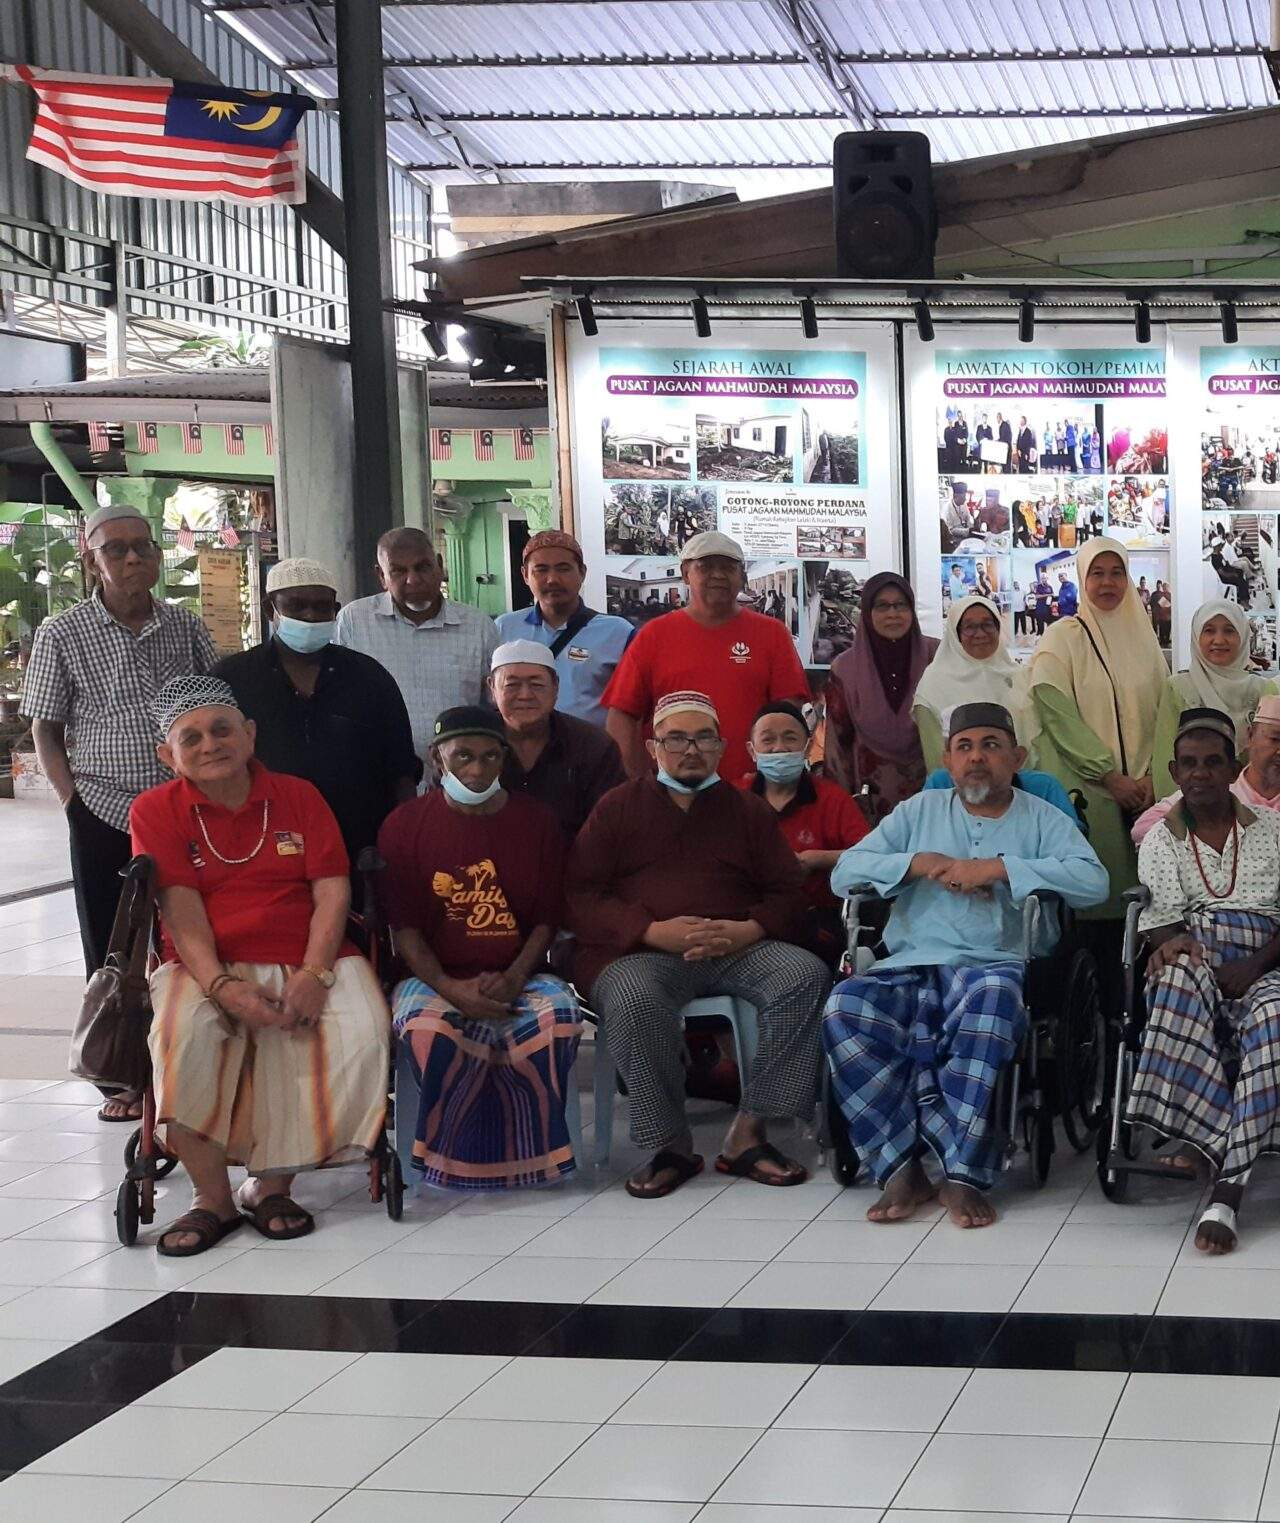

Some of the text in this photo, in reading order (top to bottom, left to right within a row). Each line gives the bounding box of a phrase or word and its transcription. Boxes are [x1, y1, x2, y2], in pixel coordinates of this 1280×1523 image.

[672, 360, 795, 377] SEJARAH AWAL
[947, 362, 1024, 375] LAWATAN
[610, 379, 855, 396] PUSAT JAGAAN MAHMUDAH MALAYSIA
[947, 382, 987, 394] PUSAT
[990, 382, 1039, 396] JAGAAN
[1042, 382, 1125, 394] MAHMUDAH
[1212, 379, 1252, 391] PUSAT
[726, 498, 866, 508] GOTONG-ROYONG PERDANA
[722, 506, 868, 517] PUSAT JAGAAN MAHMUDAH MALAYSIA
[466, 902, 516, 930] Day
